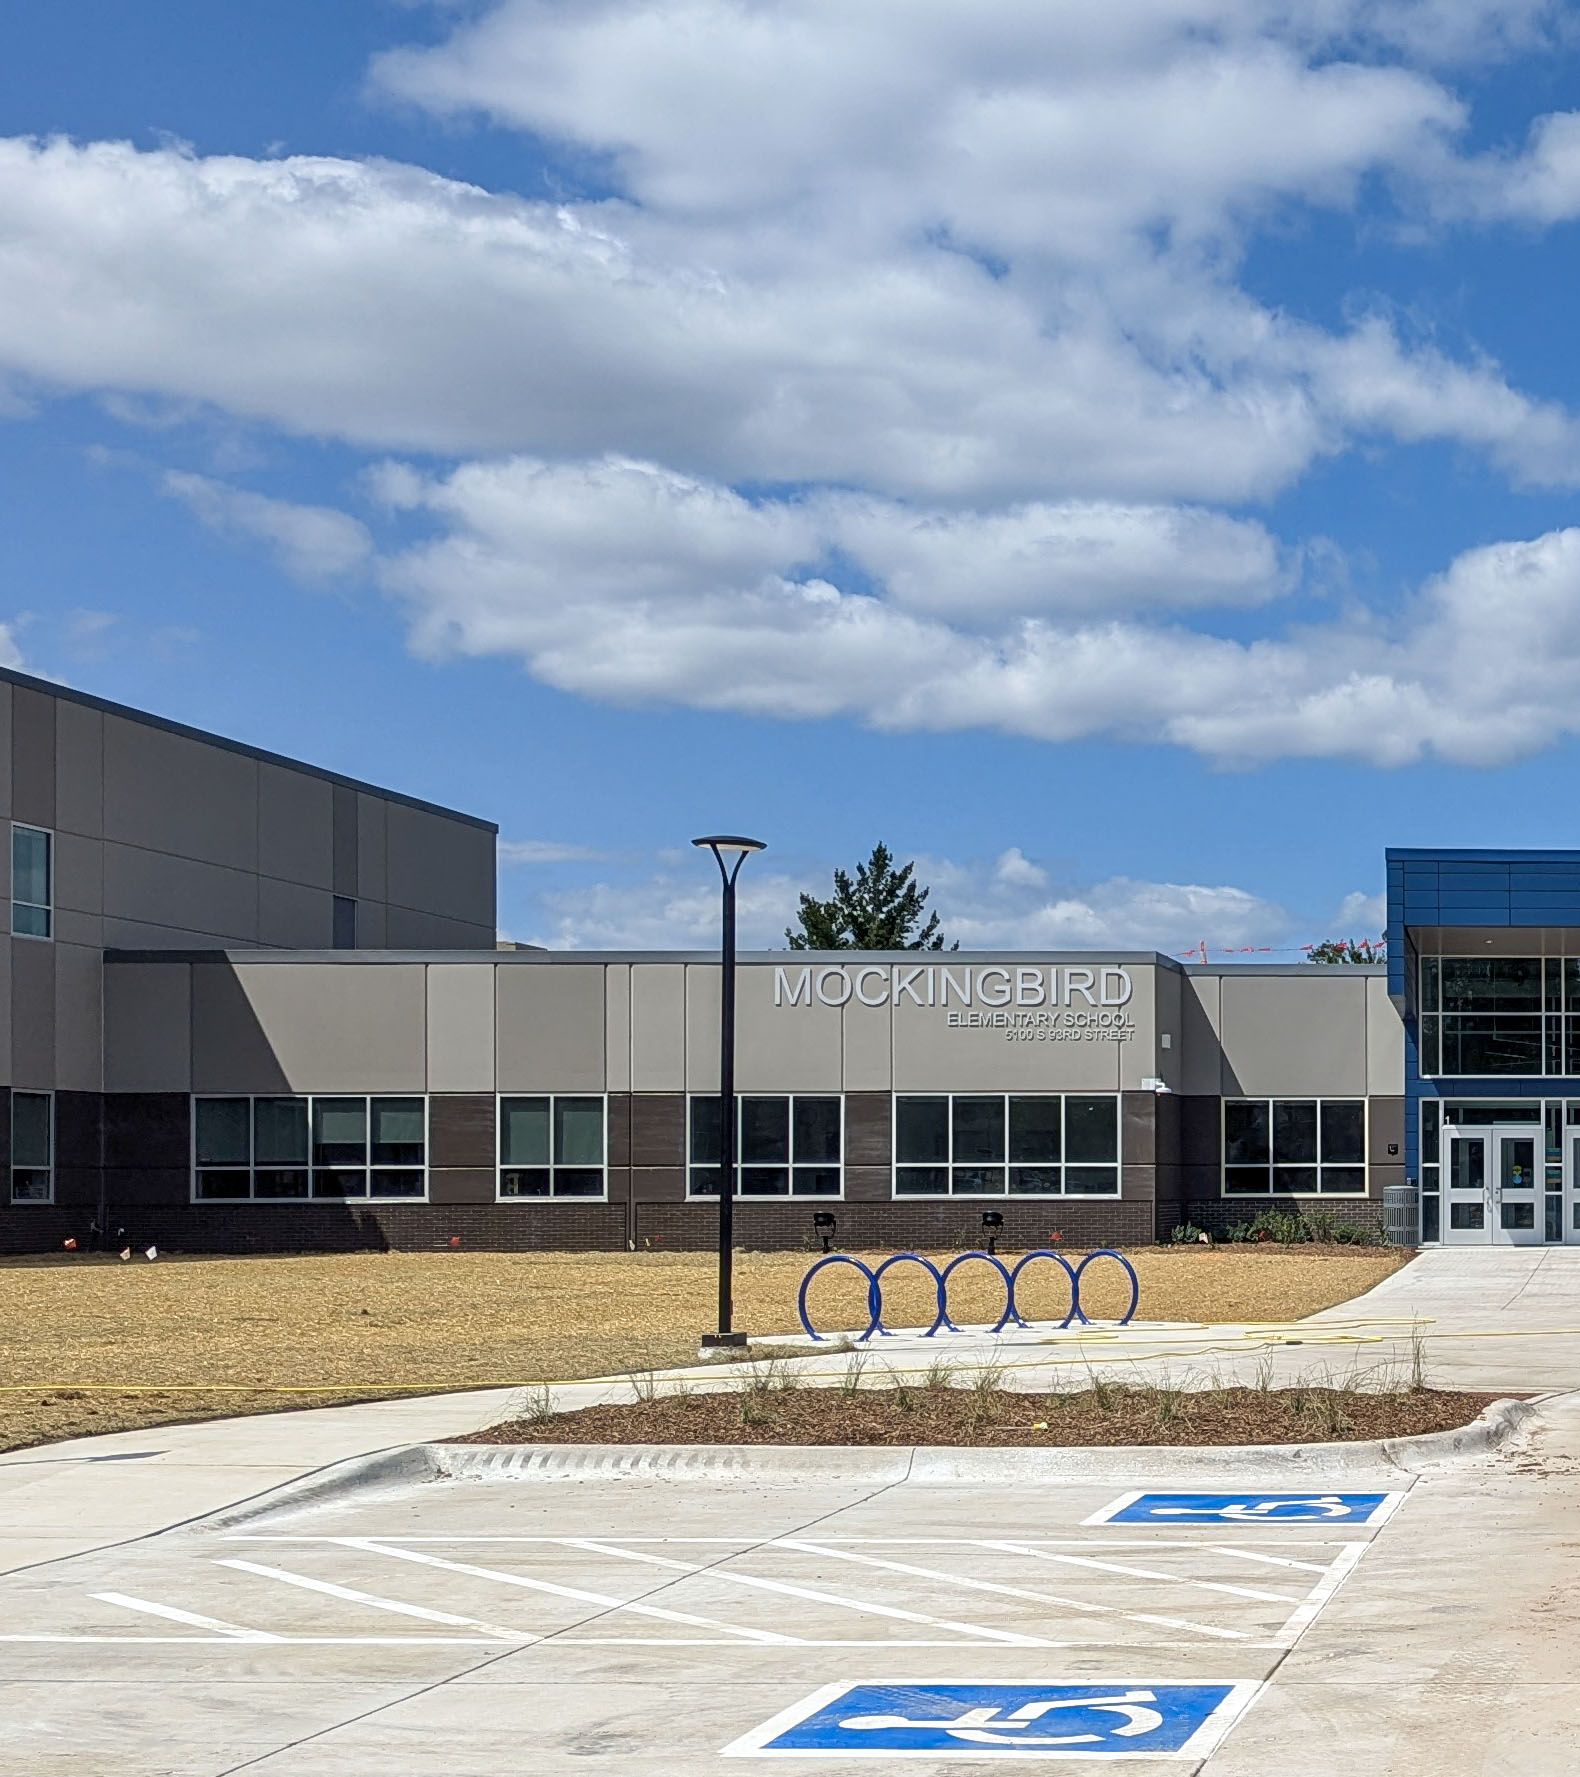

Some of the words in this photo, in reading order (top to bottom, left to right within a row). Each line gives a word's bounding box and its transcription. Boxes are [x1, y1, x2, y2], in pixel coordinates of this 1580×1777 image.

[773, 967, 1132, 1005] MOCKINGBIRD
[947, 1012, 1060, 1027] ELEMENTARY
[1064, 1012, 1134, 1027] SCHOOL
[1006, 1030, 1034, 1041] 5100
[1037, 1030, 1046, 1041] S
[1048, 1030, 1081, 1041] 93RD
[1084, 1030, 1134, 1041] STREET
